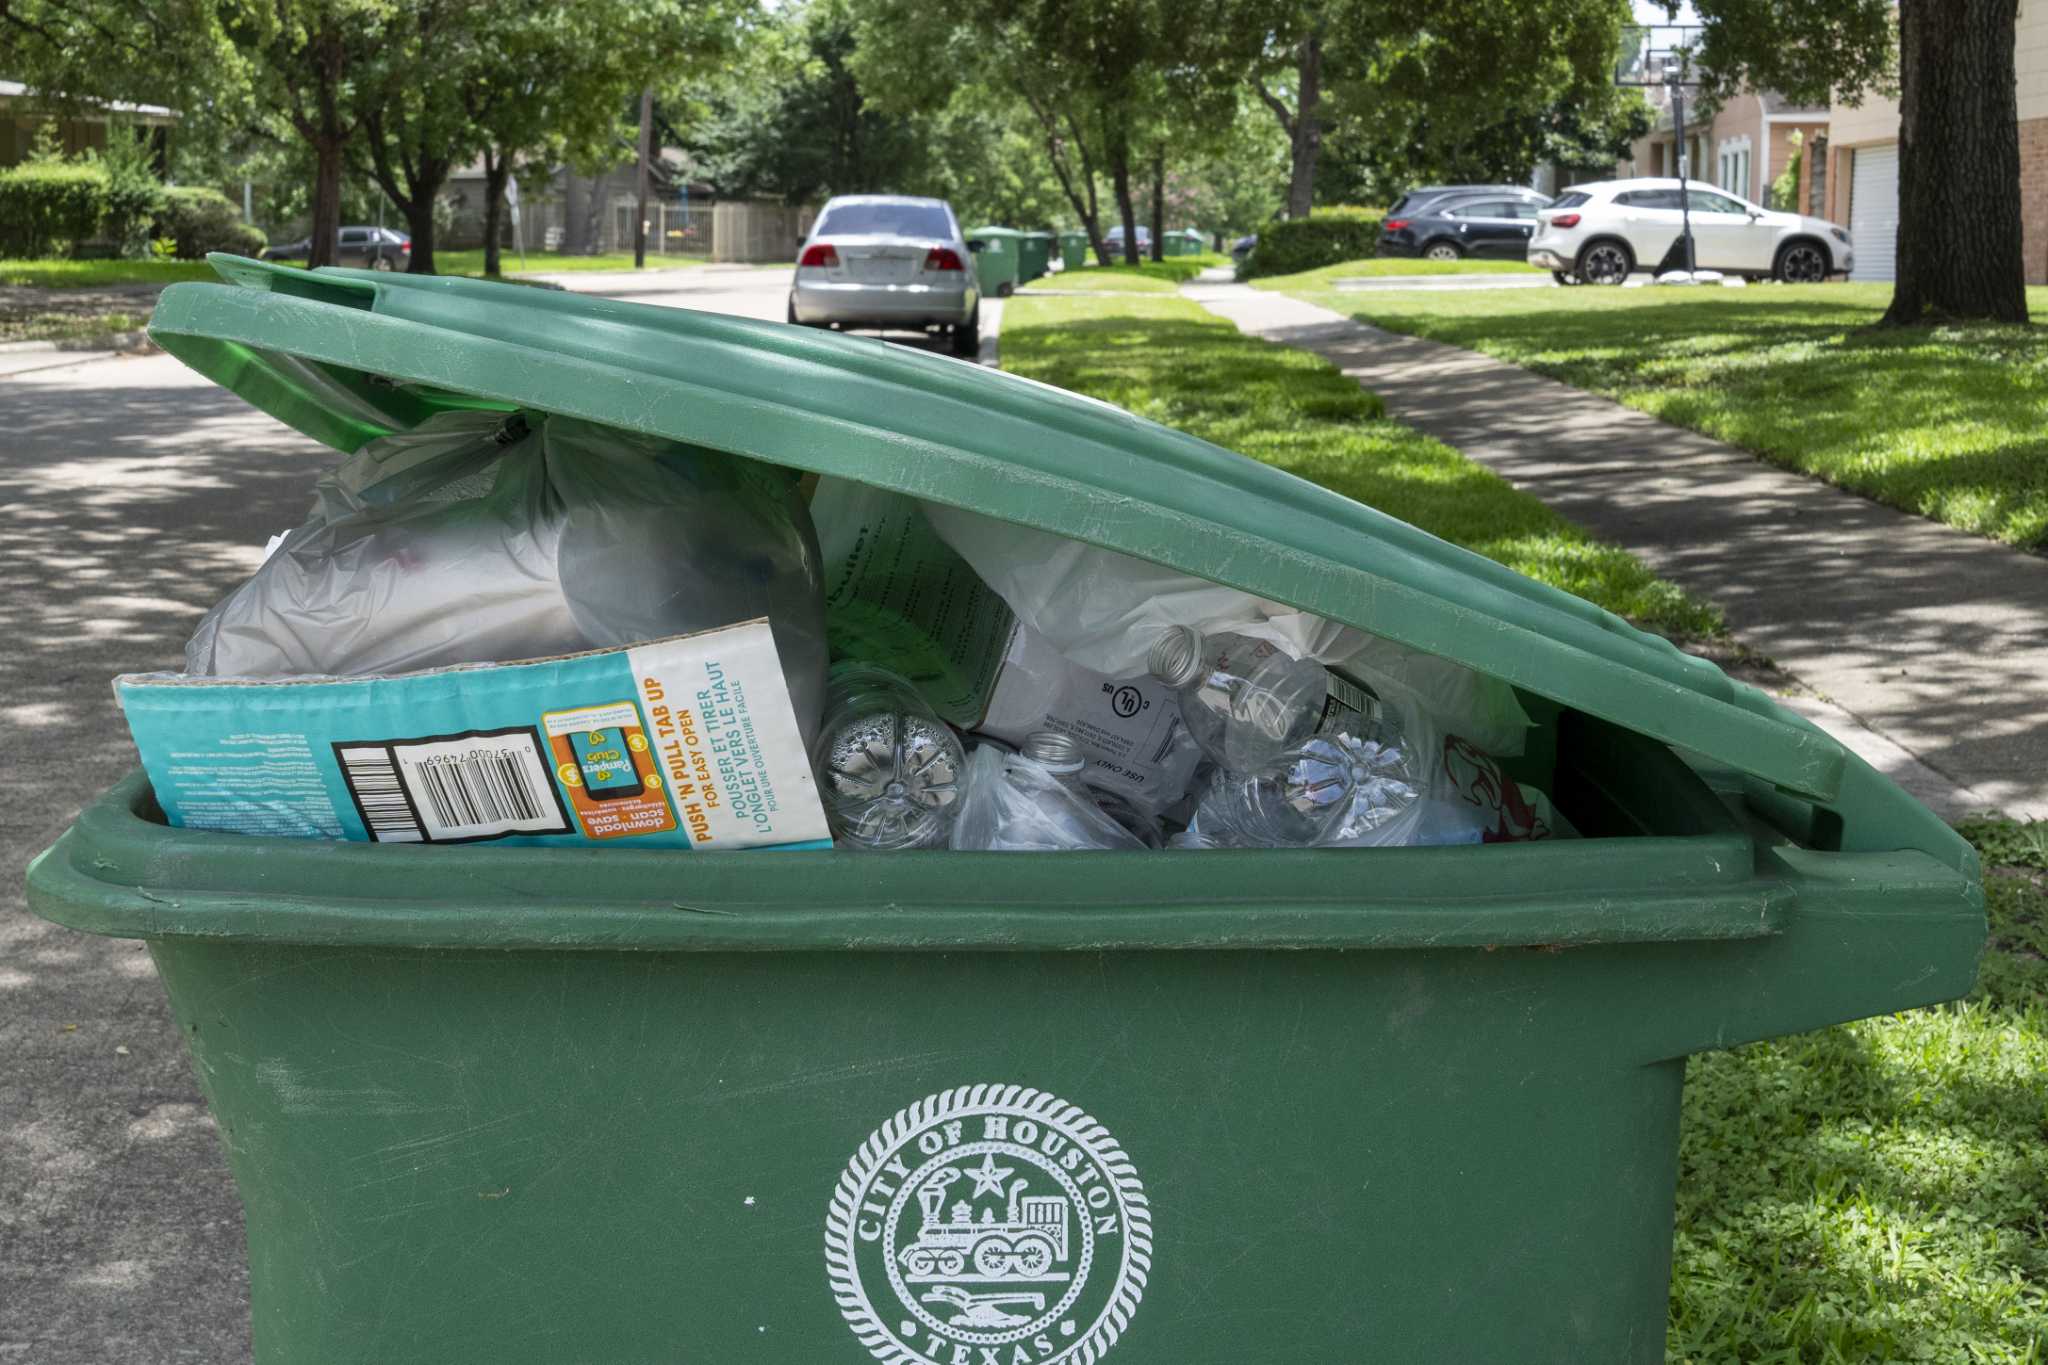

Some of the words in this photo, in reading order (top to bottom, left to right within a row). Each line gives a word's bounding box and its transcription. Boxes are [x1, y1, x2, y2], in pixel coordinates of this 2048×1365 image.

[644, 678, 665, 702] UP
[705, 661, 729, 703] HAUT
[697, 689, 721, 734] TIRER
[731, 680, 749, 718] FACILE
[652, 705, 675, 738] TAB
[677, 709, 699, 746] OPEN
[719, 707, 737, 726] LE
[587, 750, 620, 761] Club
[708, 737, 728, 754] ET
[726, 729, 749, 767] VERS
[743, 716, 765, 769] OUVERTURE
[426, 752, 466, 766] 74969
[582, 760, 632, 773] Pampers
[664, 740, 690, 780] PULL
[689, 750, 710, 781] EASY
[717, 756, 750, 819] POUSSER
[758, 770, 771, 788] UNE
[1120, 769, 1145, 784] USE
[677, 783, 696, 801] 'N
[701, 783, 720, 809] FOR
[738, 771, 772, 833] L'ONGLET
[765, 788, 780, 812] POUR
[587, 815, 619, 825] save
[594, 817, 664, 836] download
[630, 808, 664, 821] scan
[684, 803, 713, 844] PUSH
[858, 1153, 913, 1242] CITY
[919, 1120, 963, 1155] OF
[983, 1115, 1119, 1238] HOUSTON
[926, 1333, 1054, 1365] TEXAS
